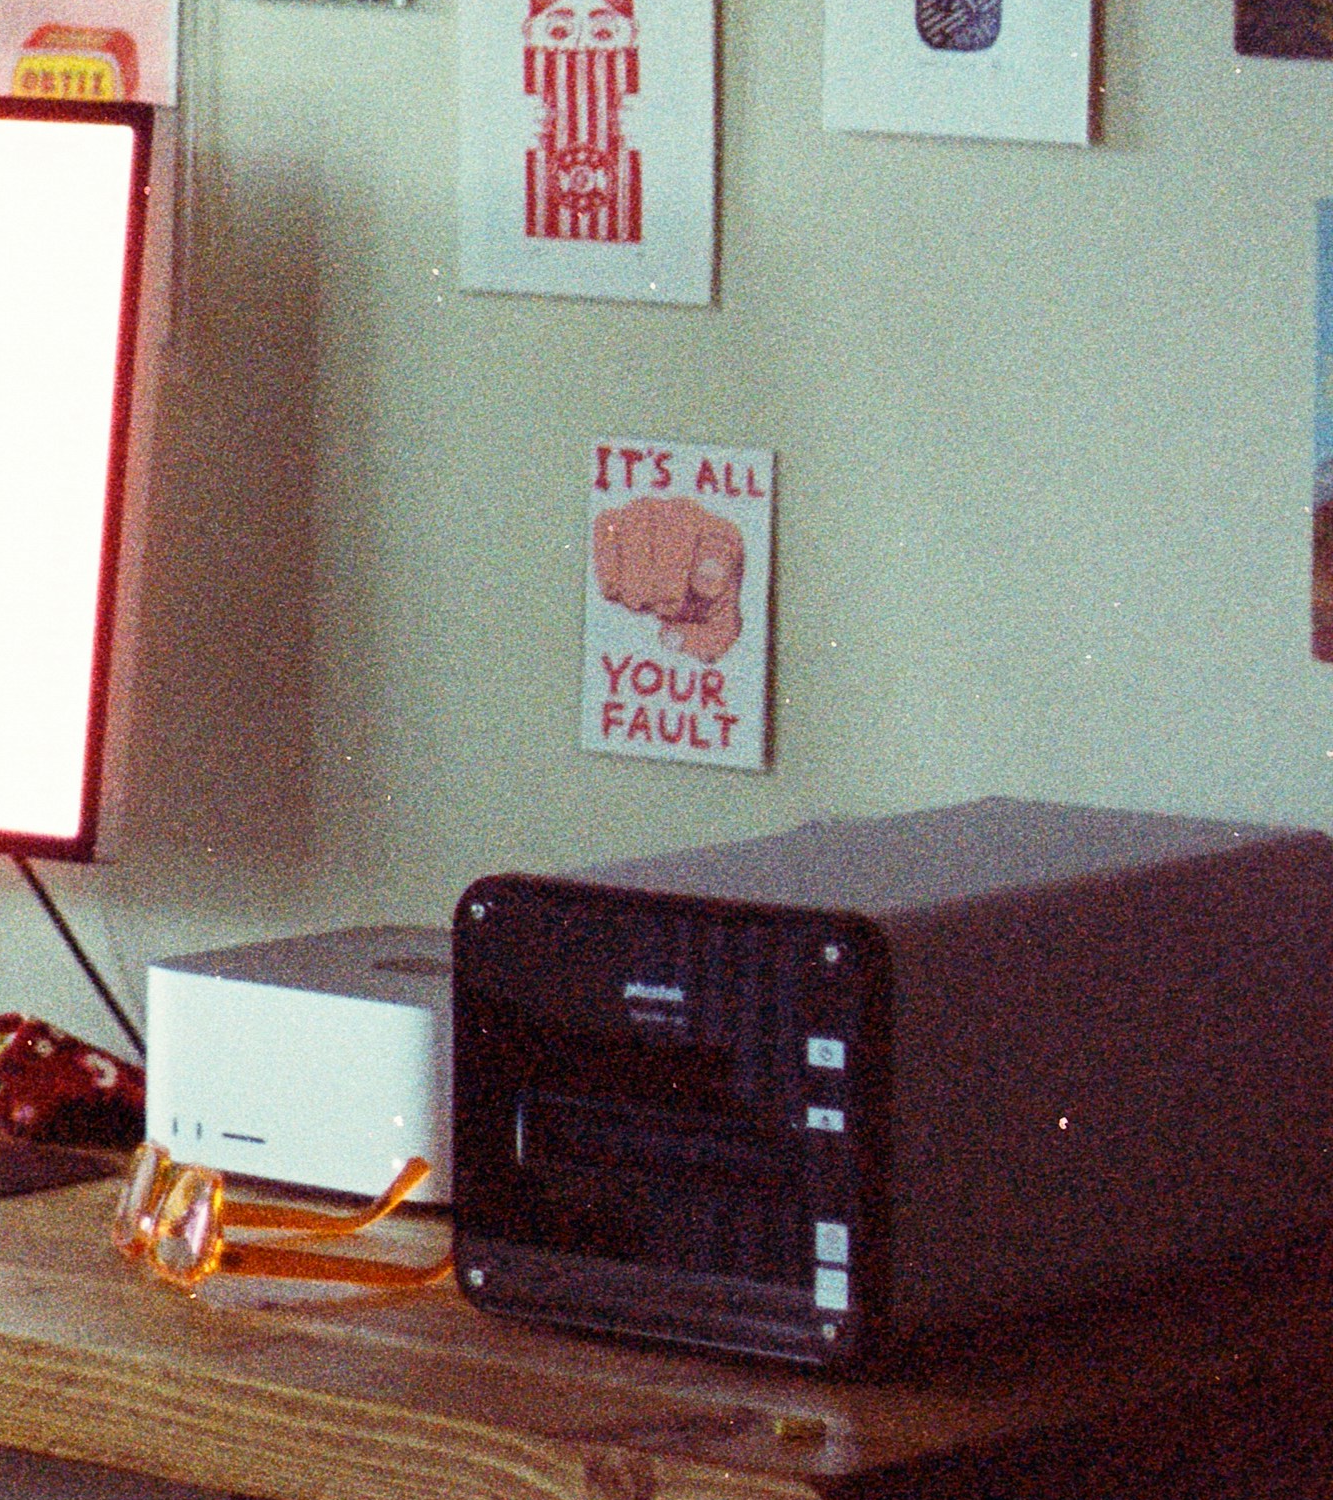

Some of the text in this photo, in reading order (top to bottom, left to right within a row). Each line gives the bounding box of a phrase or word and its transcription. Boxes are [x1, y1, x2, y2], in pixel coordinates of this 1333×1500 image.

[594, 445, 765, 499] IT'S ALL
[601, 652, 727, 709] YOUR
[600, 701, 739, 750] FAULT
